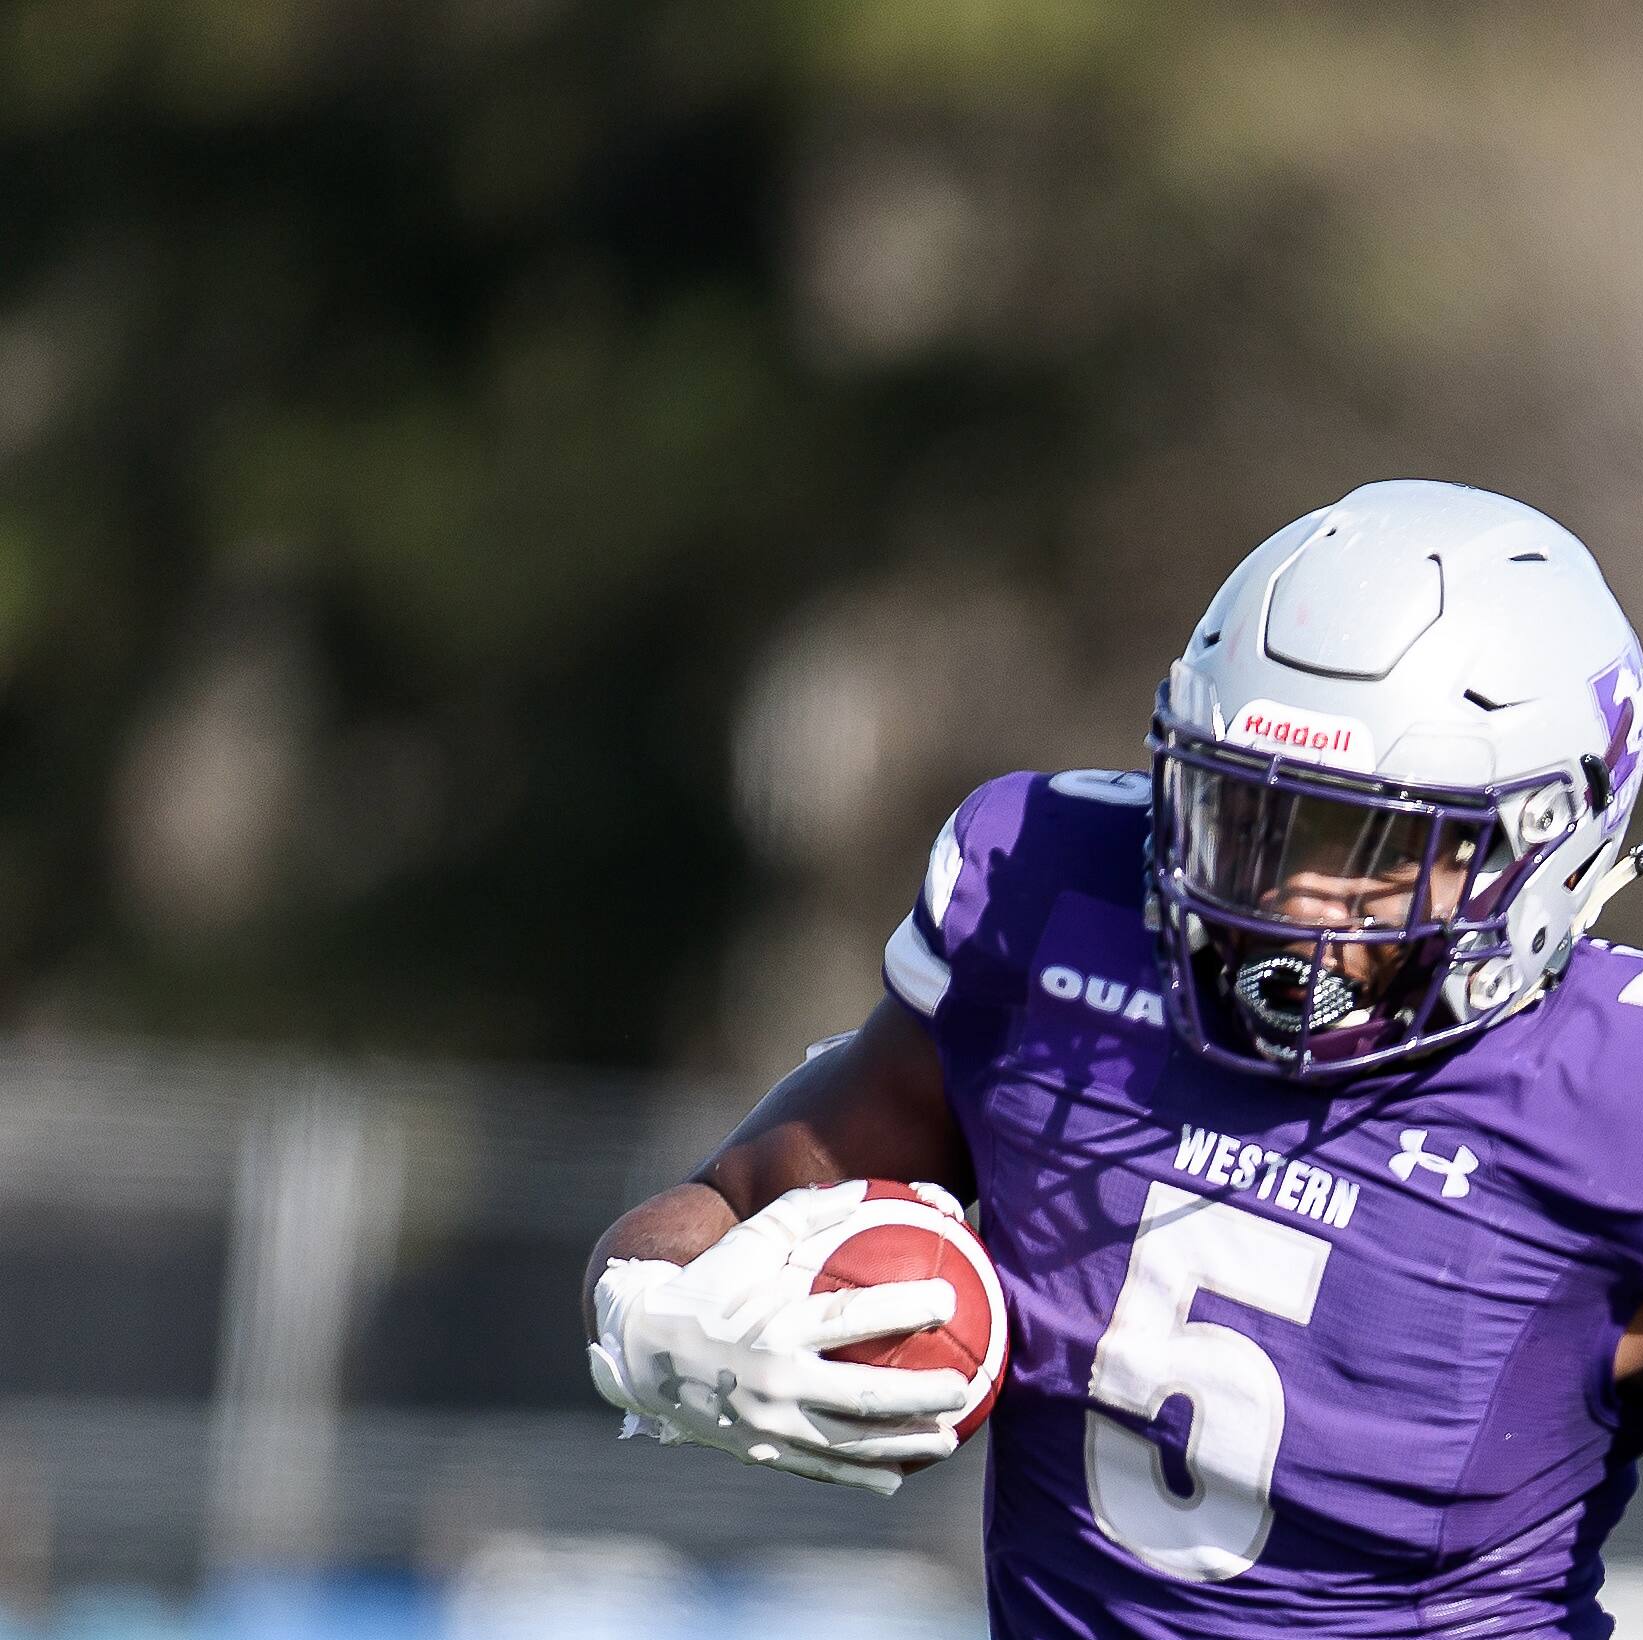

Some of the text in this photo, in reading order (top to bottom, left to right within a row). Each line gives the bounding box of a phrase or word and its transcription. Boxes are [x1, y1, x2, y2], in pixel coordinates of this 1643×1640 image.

[1245, 713, 1352, 752] Riddell
[1040, 965, 1166, 1028] OUA
[1173, 1123, 1361, 1229] WESTERN
[1084, 1178, 1333, 1583] 5
